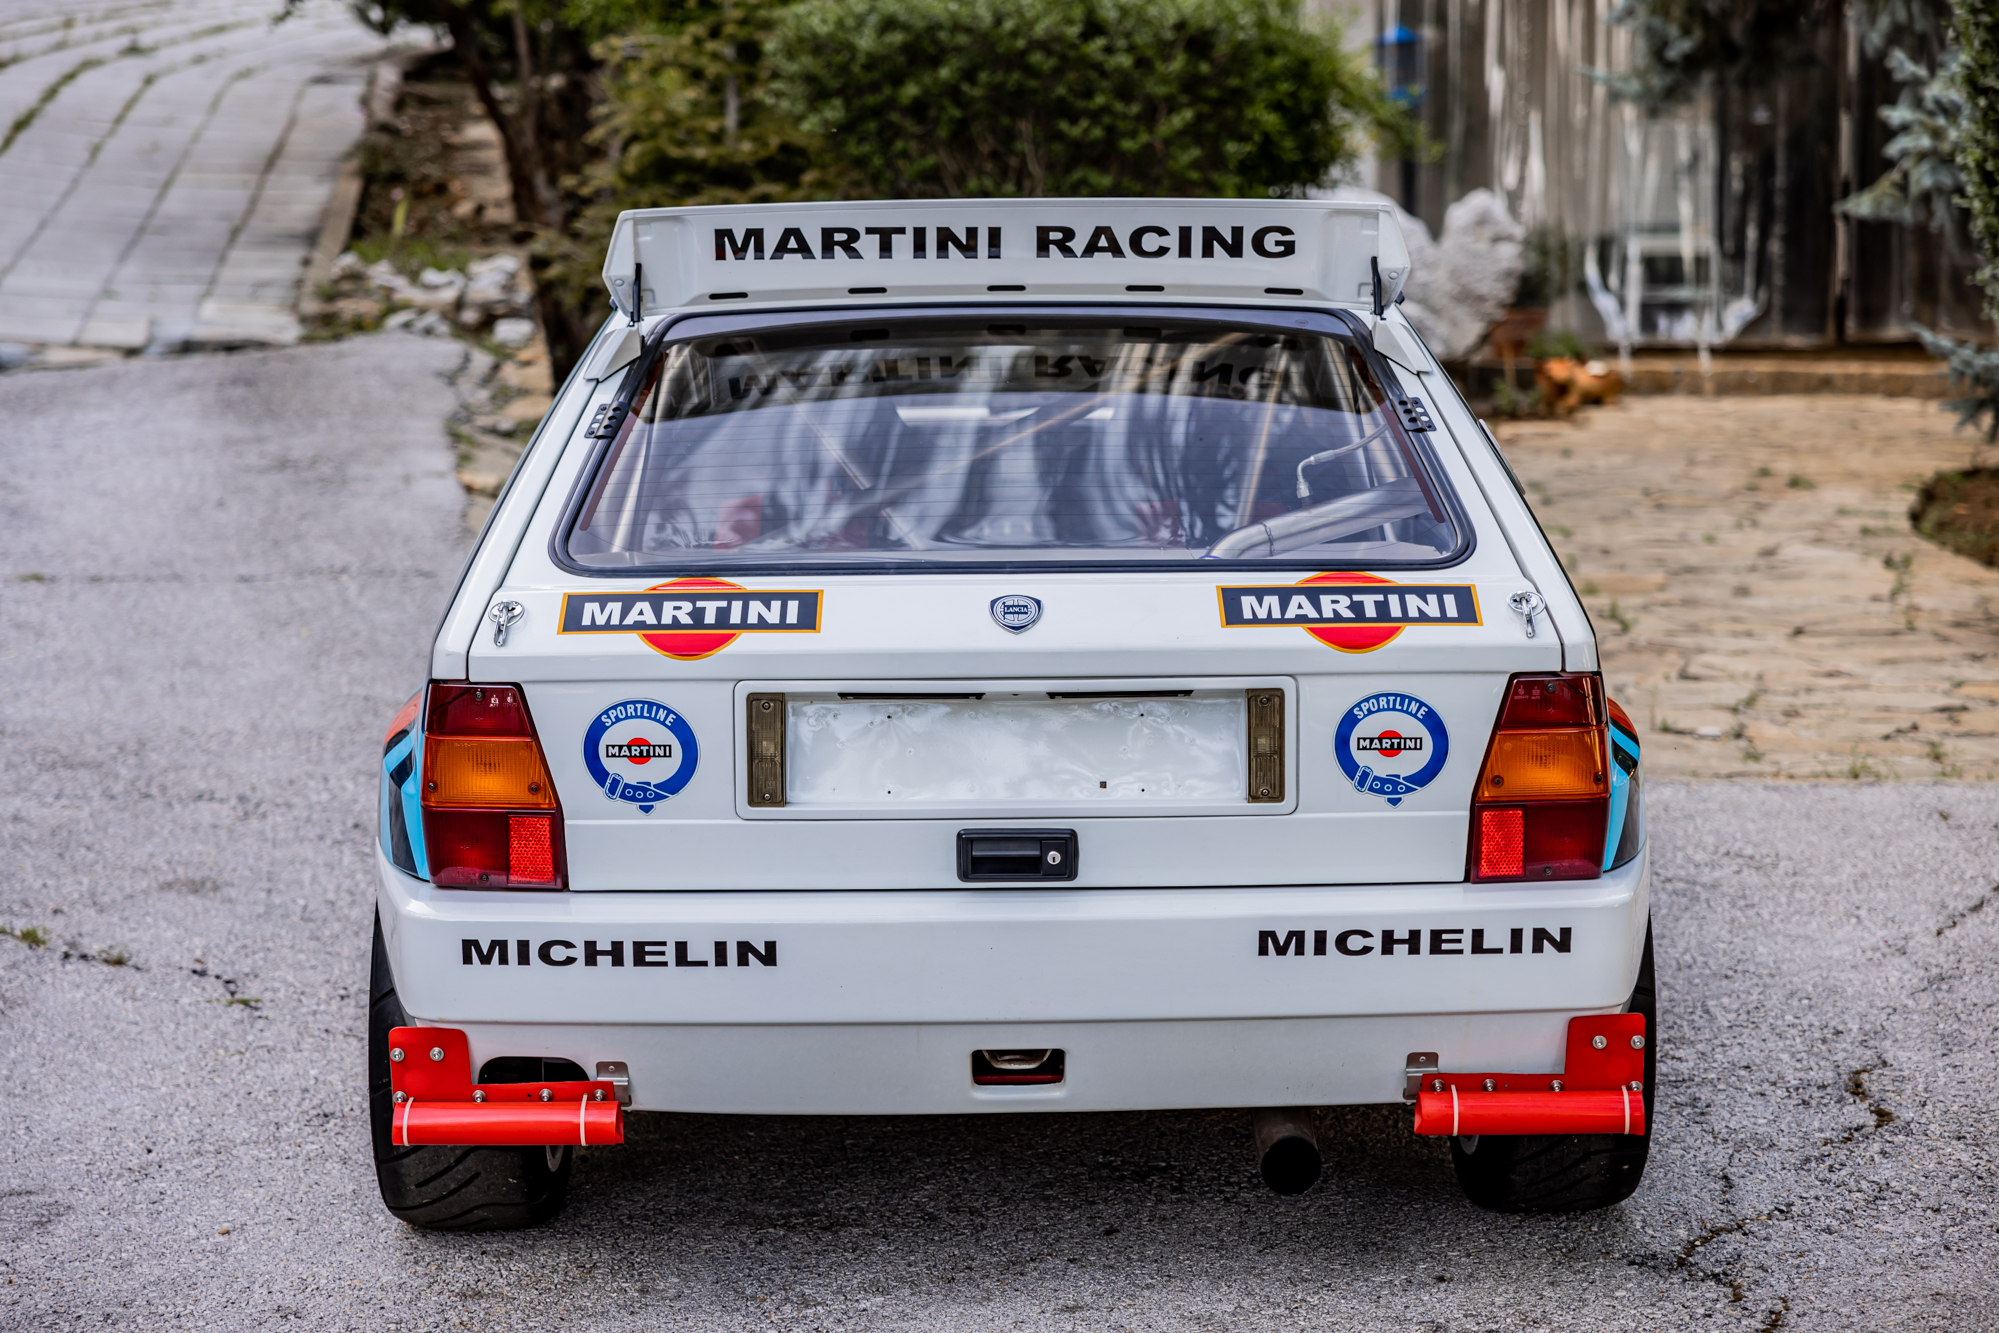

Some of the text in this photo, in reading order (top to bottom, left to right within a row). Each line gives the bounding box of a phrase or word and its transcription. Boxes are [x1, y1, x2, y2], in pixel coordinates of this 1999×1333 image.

[714, 225, 1296, 261] MARTINI RACING
[581, 600, 799, 626] MARTINI
[1240, 594, 1459, 620] MARTINI
[601, 703, 676, 727] SPORTLINE
[1353, 696, 1428, 720] SPORTLINE
[607, 745, 671, 757] MARTINI
[1358, 738, 1422, 750] MARTINI
[461, 939, 777, 967] MICHELIN
[1258, 927, 1572, 956] MICHELIN
